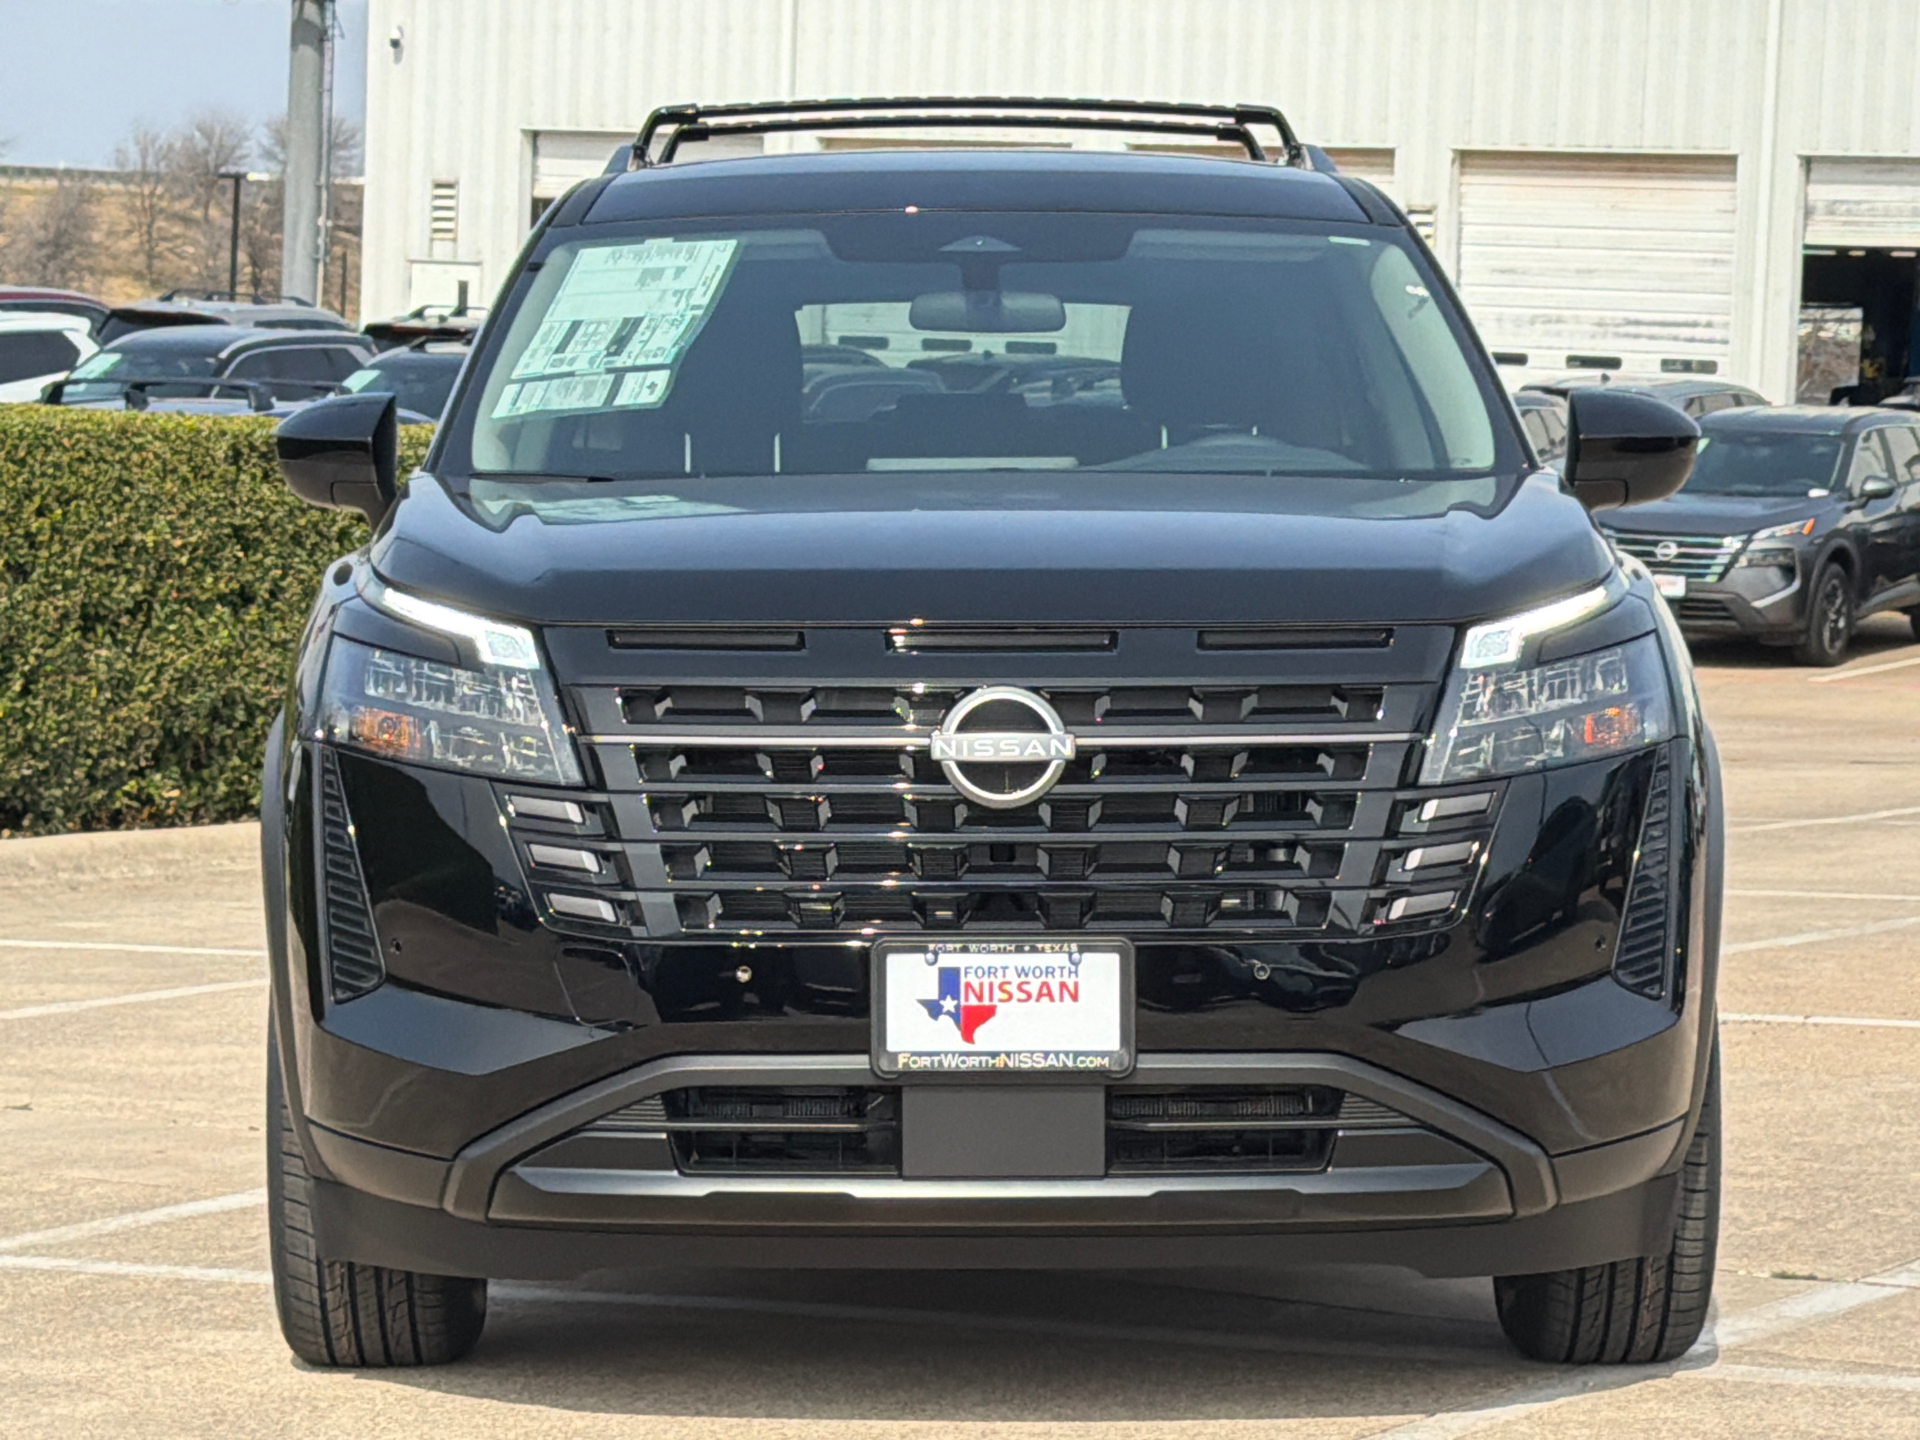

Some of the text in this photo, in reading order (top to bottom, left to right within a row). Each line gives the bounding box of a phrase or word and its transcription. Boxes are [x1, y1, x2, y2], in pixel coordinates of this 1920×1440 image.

[935, 738, 1072, 757] NISSAN
[928, 943, 1079, 954] FORT WORTH TEXAS
[963, 965, 1079, 979] FORT WORTH
[963, 980, 1080, 1003] NISSAN
